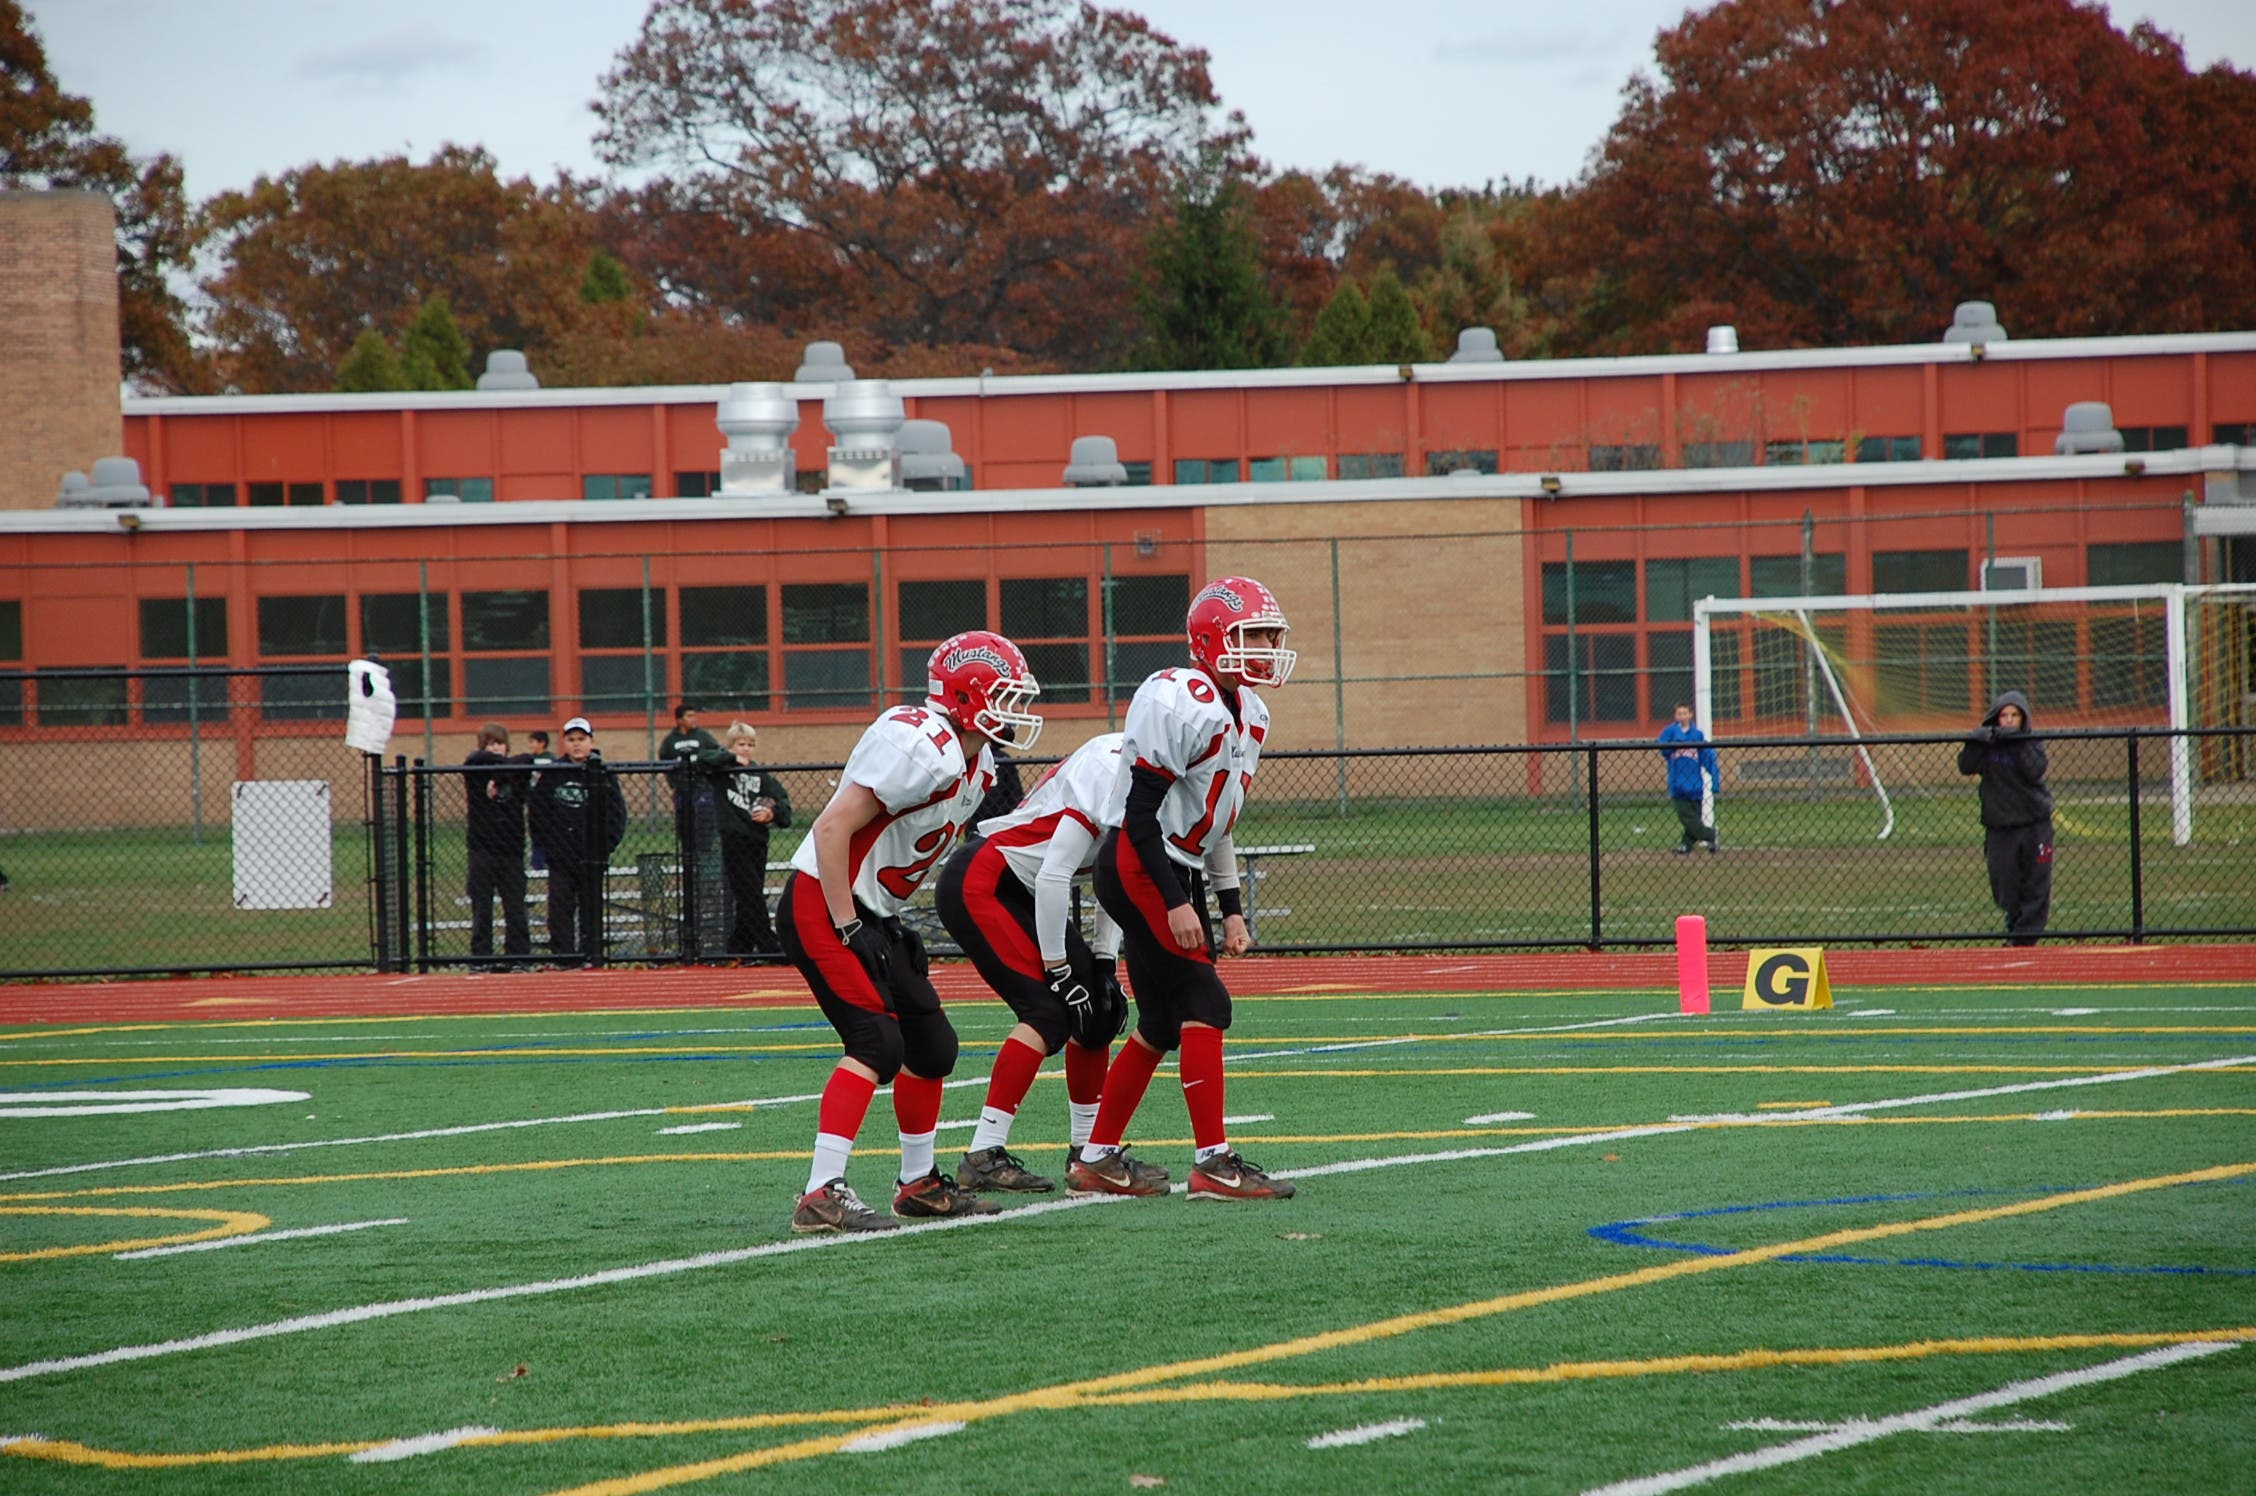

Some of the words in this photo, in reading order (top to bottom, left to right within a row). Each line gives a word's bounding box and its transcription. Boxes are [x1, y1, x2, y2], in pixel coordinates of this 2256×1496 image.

[943, 646, 1012, 678] Mustangs
[1151, 667, 1215, 704] 10
[888, 706, 953, 757] 21
[1755, 953, 1810, 1006] G
